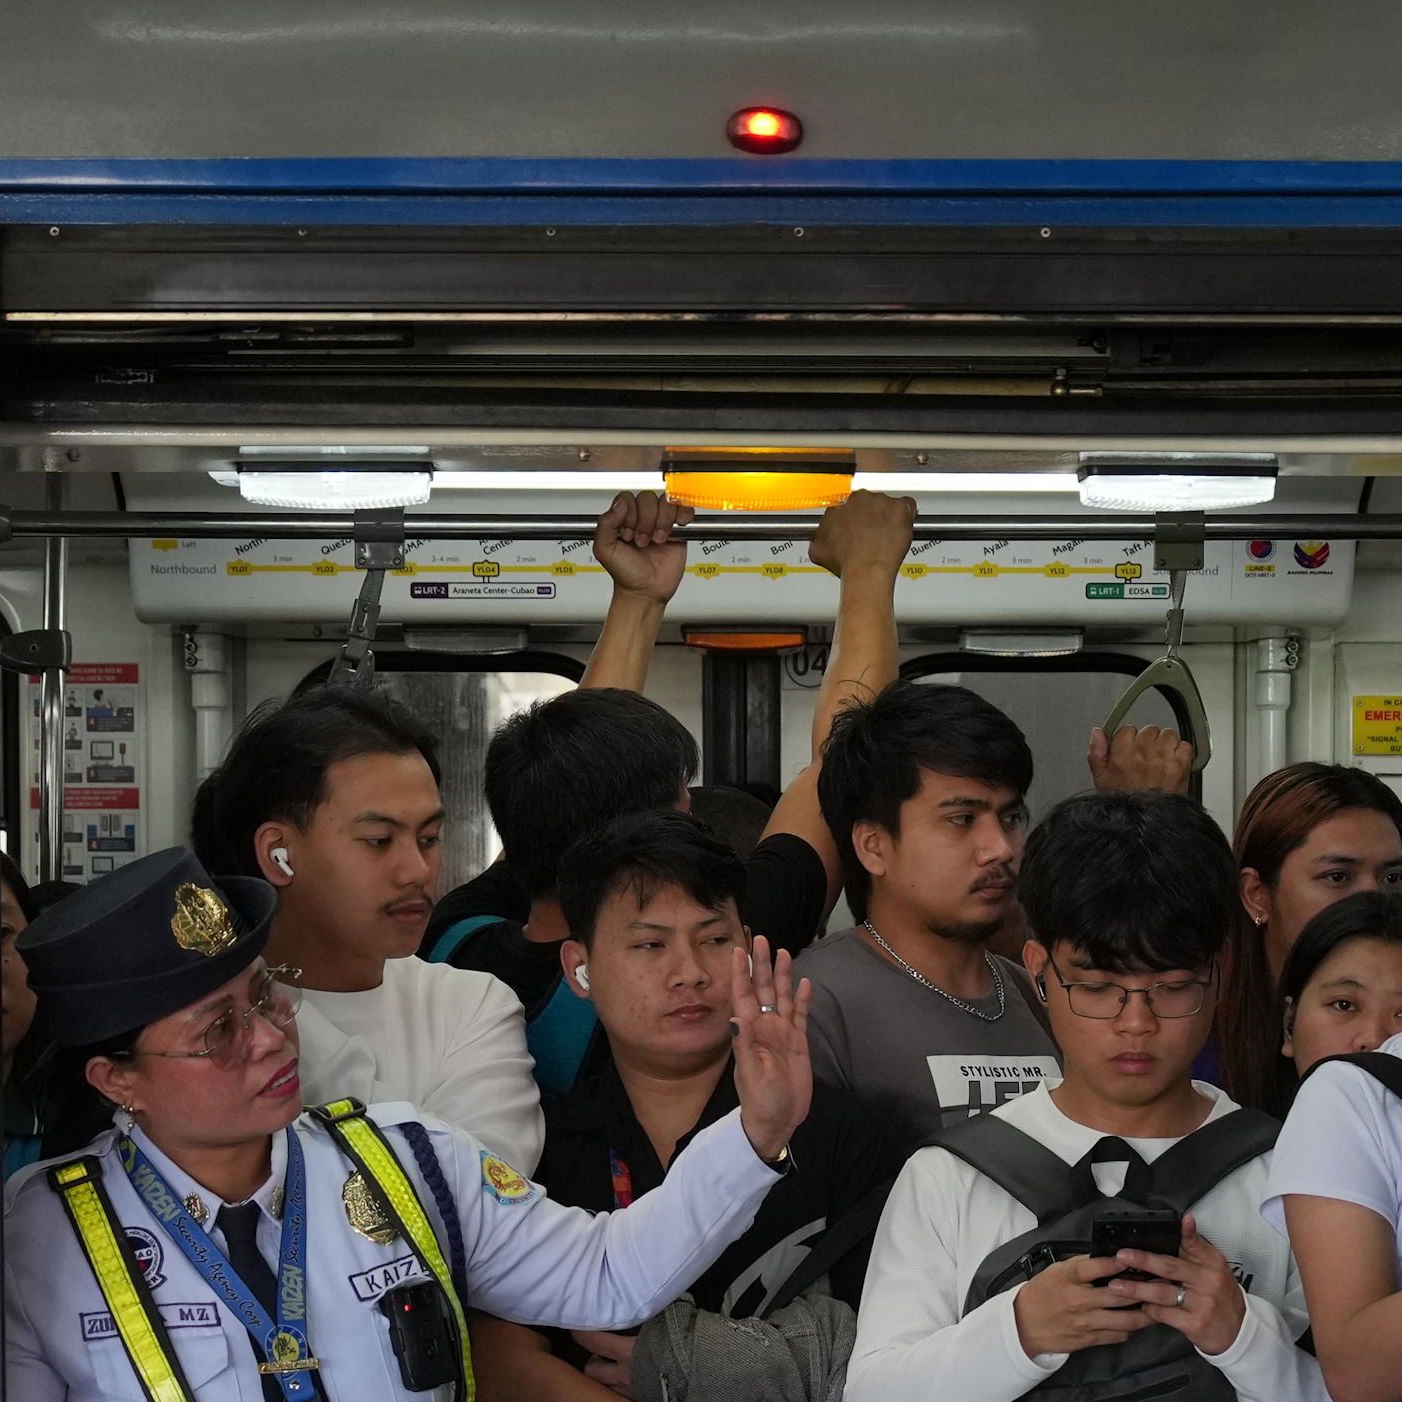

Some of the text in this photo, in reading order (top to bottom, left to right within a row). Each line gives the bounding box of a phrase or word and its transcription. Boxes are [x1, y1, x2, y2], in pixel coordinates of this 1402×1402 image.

[235, 539, 263, 555] North
[321, 539, 351, 555] Quezo
[483, 539, 514, 555] Center
[983, 540, 1009, 556] Ayala
[1122, 543, 1143, 557] Taft
[446, 555, 459, 563] min
[522, 555, 536, 563] min
[1018, 556, 1032, 564] min
[1089, 556, 1103, 564] min
[150, 564, 217, 575] Northbound
[231, 565, 248, 573] YL01
[555, 566, 573, 574] YL05
[423, 586, 446, 594] LRT-2
[453, 586, 481, 594] Araneta
[483, 586, 535, 594] Center-Cubao
[1098, 587, 1120, 595] LRT-1
[1128, 587, 1150, 595] EDSA
[960, 1066, 1047, 1078] STYLISTIC MR.
[132, 1163, 181, 1222] KAIZEN
[173, 1216, 209, 1264] Security
[207, 1262, 239, 1301] Agency
[284, 1213, 303, 1263] Security
[365, 1259, 416, 1293] KAIZ
[282, 1263, 305, 1320] KAIZEN
